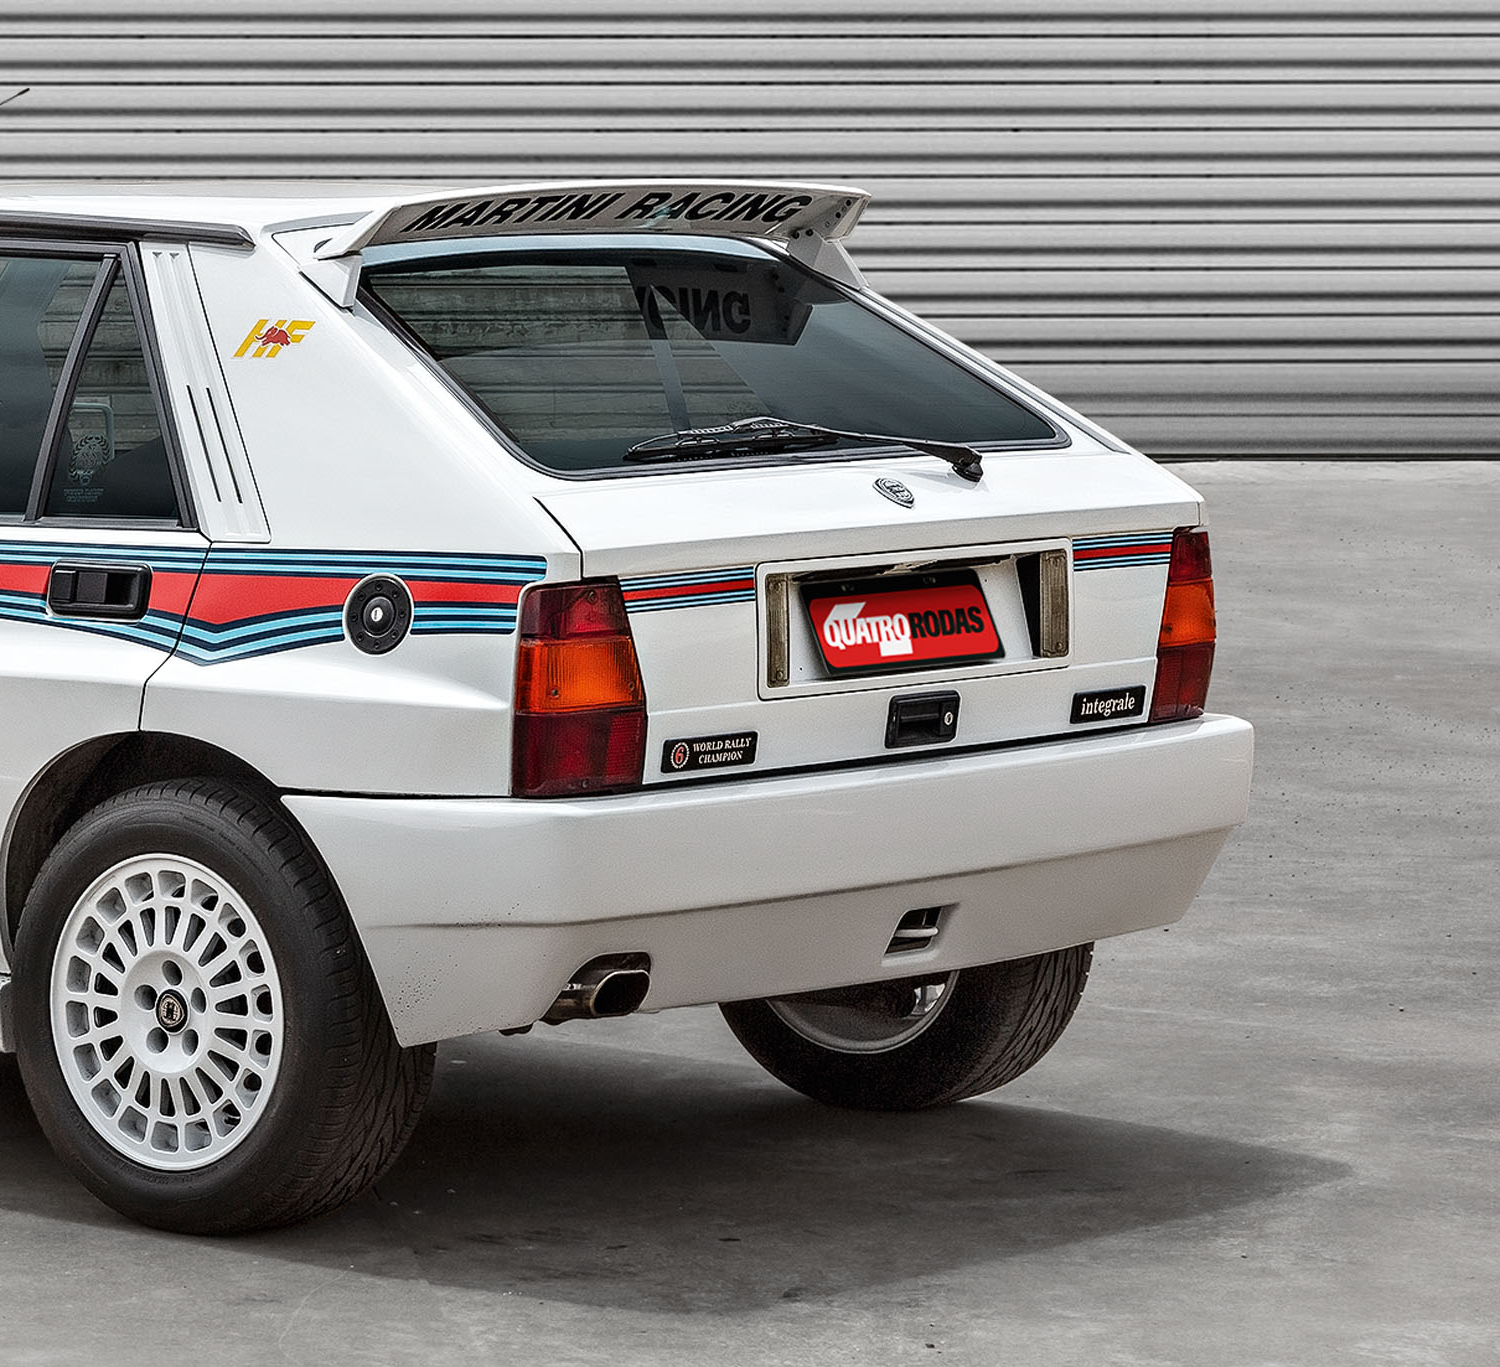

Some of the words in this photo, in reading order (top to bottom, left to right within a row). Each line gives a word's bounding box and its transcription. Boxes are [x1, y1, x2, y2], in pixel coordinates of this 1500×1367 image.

[400, 192, 626, 232] MARTINI
[615, 191, 813, 224] RACING
[1081, 692, 1135, 717] integrale
[693, 741, 723, 752] WORLD
[724, 738, 752, 749] RALLY
[675, 746, 685, 764] 6
[698, 751, 743, 764] CHAMPION
